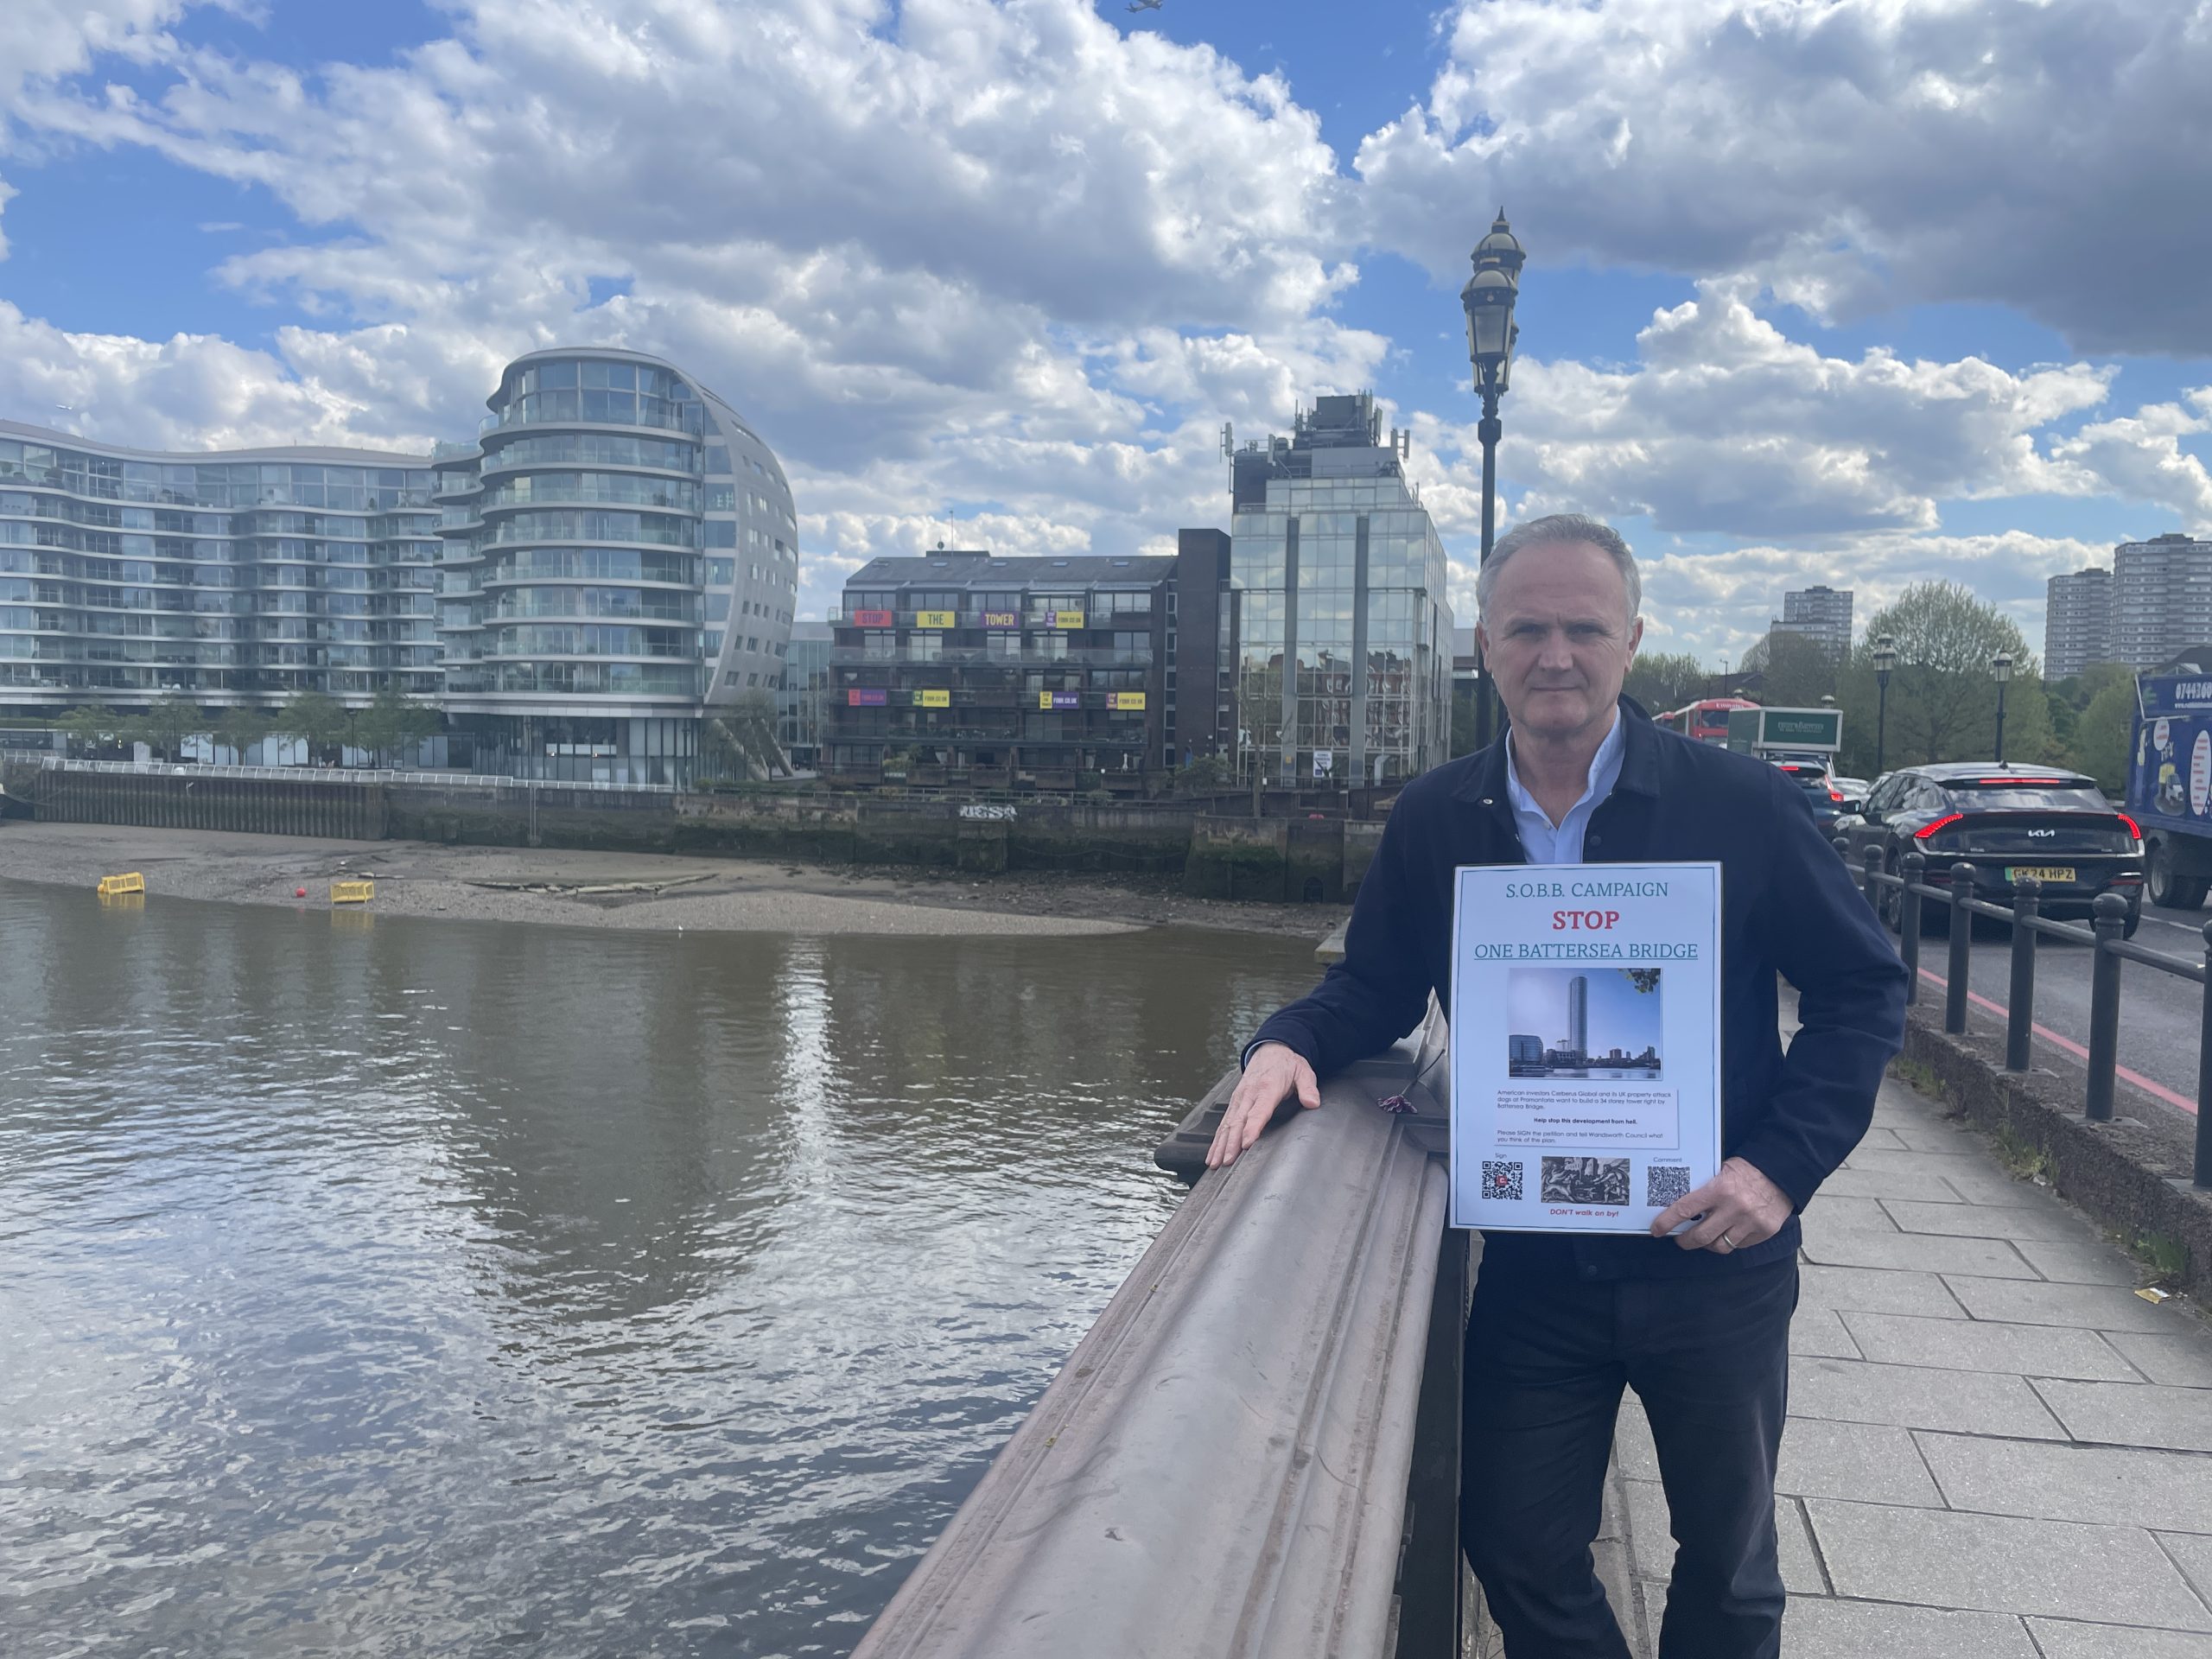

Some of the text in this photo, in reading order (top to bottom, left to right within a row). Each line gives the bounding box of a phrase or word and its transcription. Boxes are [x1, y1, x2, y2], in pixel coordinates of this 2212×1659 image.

[861, 613, 884, 624] STOP
[927, 613, 944, 626] THE
[985, 613, 1014, 626] TOWER
[2049, 868, 2073, 880] HPZ
[1506, 882, 1669, 898] S.O.B.B. CAMPAIGN
[1553, 910, 1620, 931] STOP
[1474, 944, 1698, 959] ONE BATTERSEA BRIDGE
